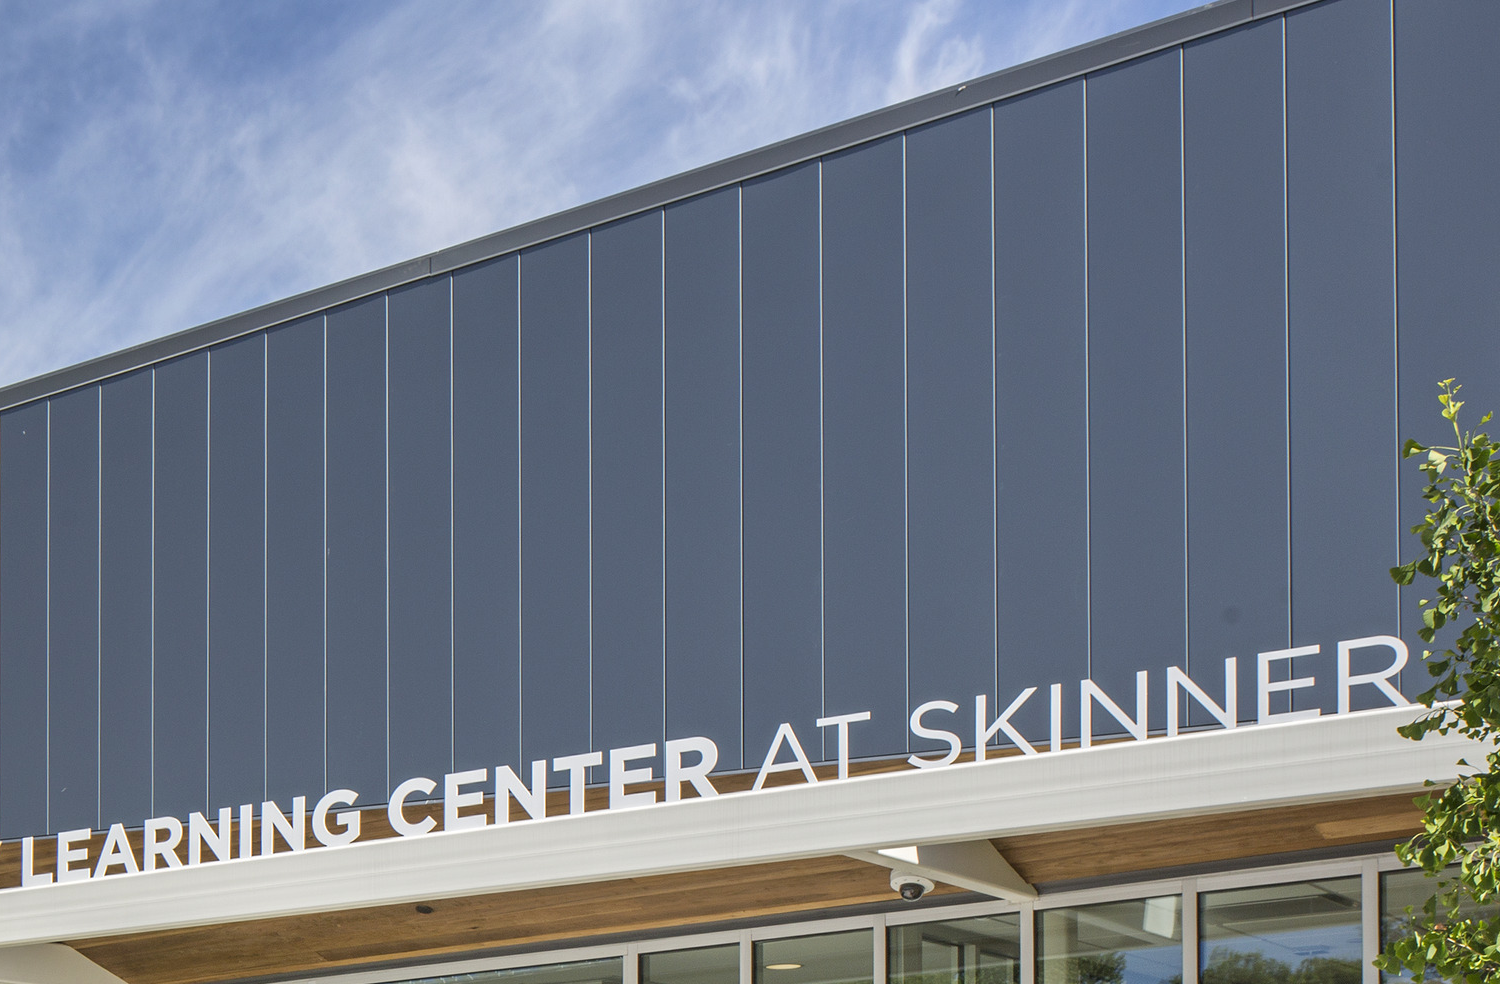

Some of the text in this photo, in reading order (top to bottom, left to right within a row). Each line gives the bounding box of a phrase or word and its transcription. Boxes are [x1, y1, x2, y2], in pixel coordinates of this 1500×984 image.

[22, 789, 361, 888] LEARNING
[387, 736, 719, 838] CENTER
[751, 711, 871, 792] AT
[907, 635, 1412, 770] SKINNER
